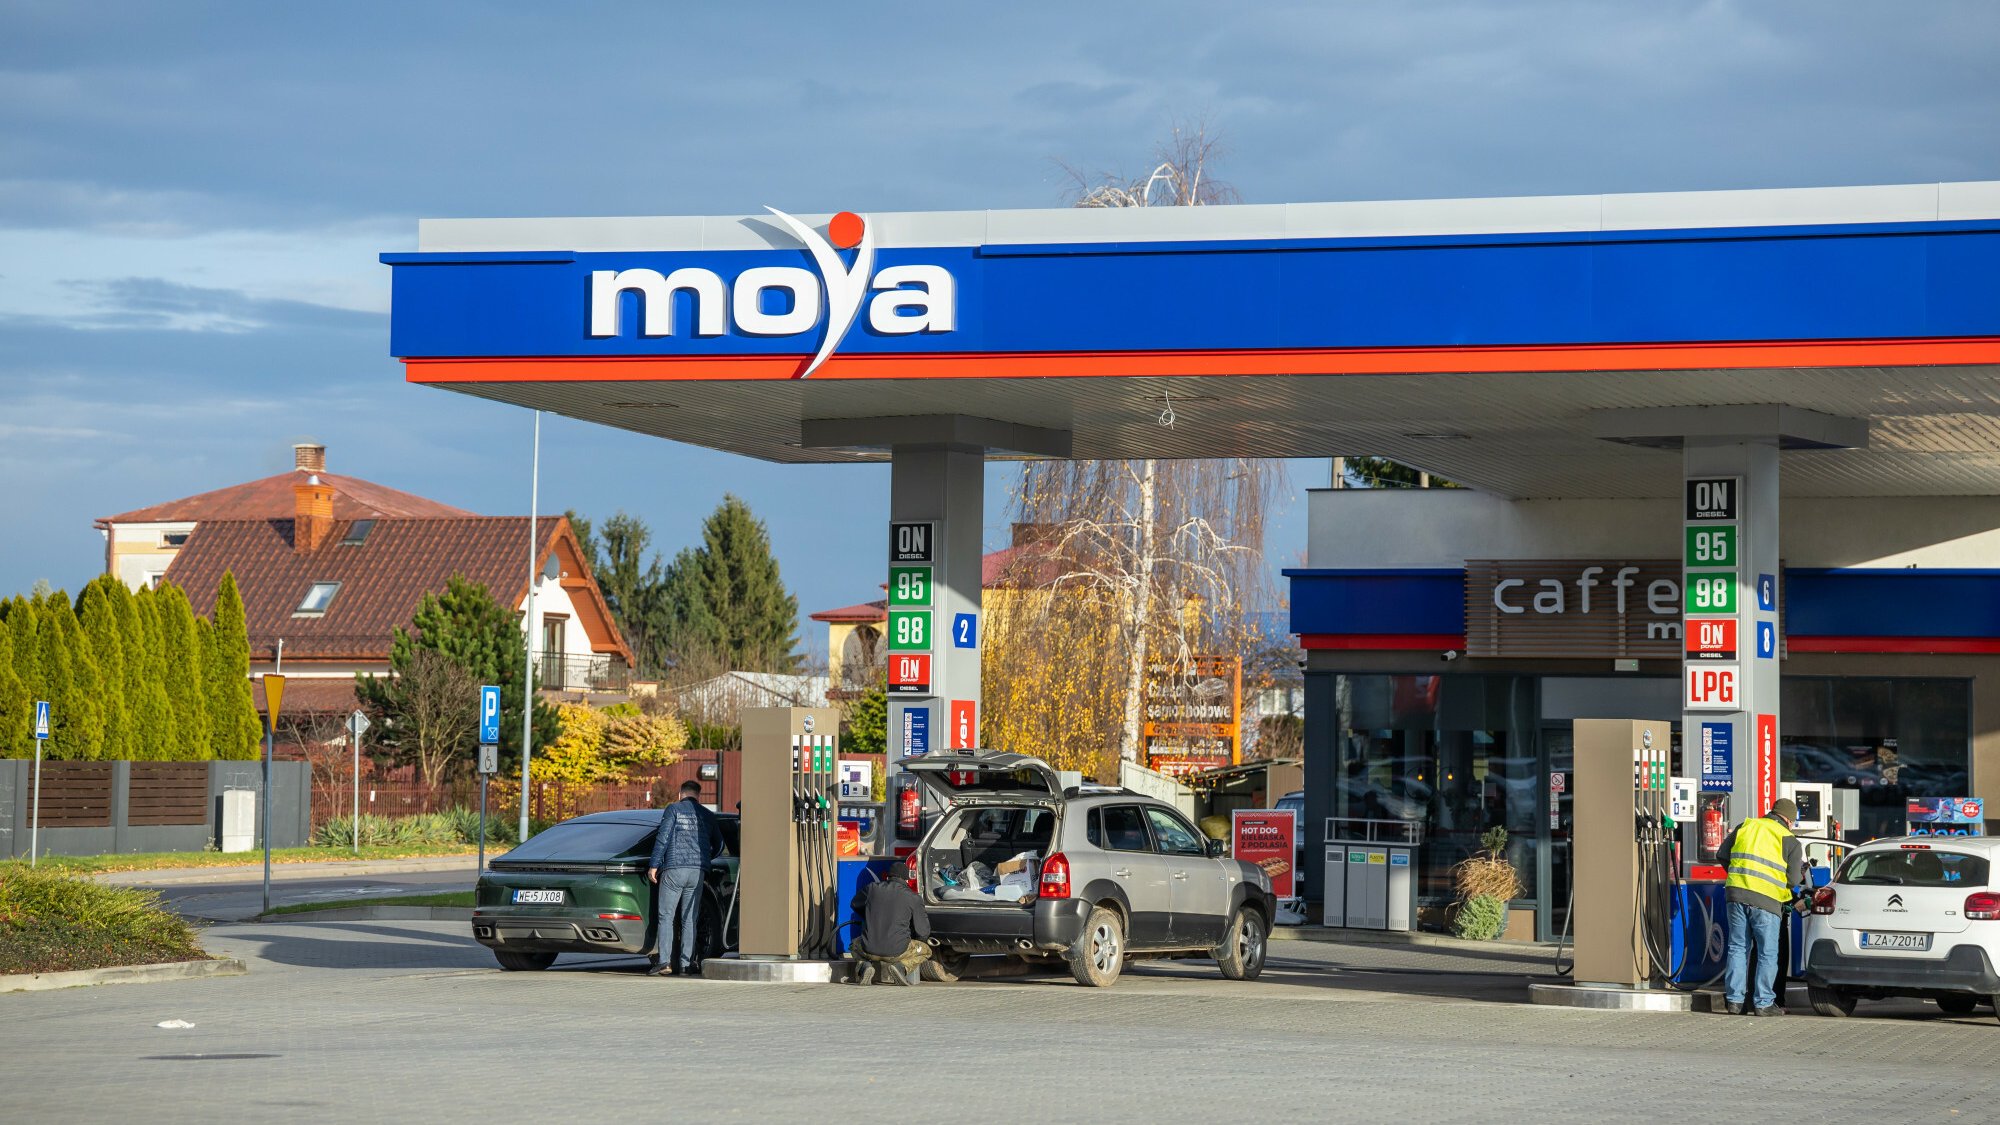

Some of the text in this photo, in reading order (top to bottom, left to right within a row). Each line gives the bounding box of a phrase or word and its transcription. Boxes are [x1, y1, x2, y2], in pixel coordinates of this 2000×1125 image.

[591, 204, 957, 379] moya
[1695, 482, 1728, 510] ON
[898, 526, 925, 553] ON
[1695, 532, 1727, 561] 95
[897, 572, 924, 600] 95
[1494, 566, 1680, 614] caffe
[1695, 578, 1728, 608] 98
[1763, 580, 1770, 605] 6
[897, 616, 924, 645] 98
[959, 618, 969, 643] 2
[1700, 624, 1724, 645] ON
[1763, 627, 1770, 653] 8
[900, 659, 920, 678] ON
[1691, 671, 1733, 703] LPG
[484, 691, 497, 726] P
[1241, 827, 1278, 835] HOT DOG
[1241, 841, 1289, 849] Z PODLASIA
